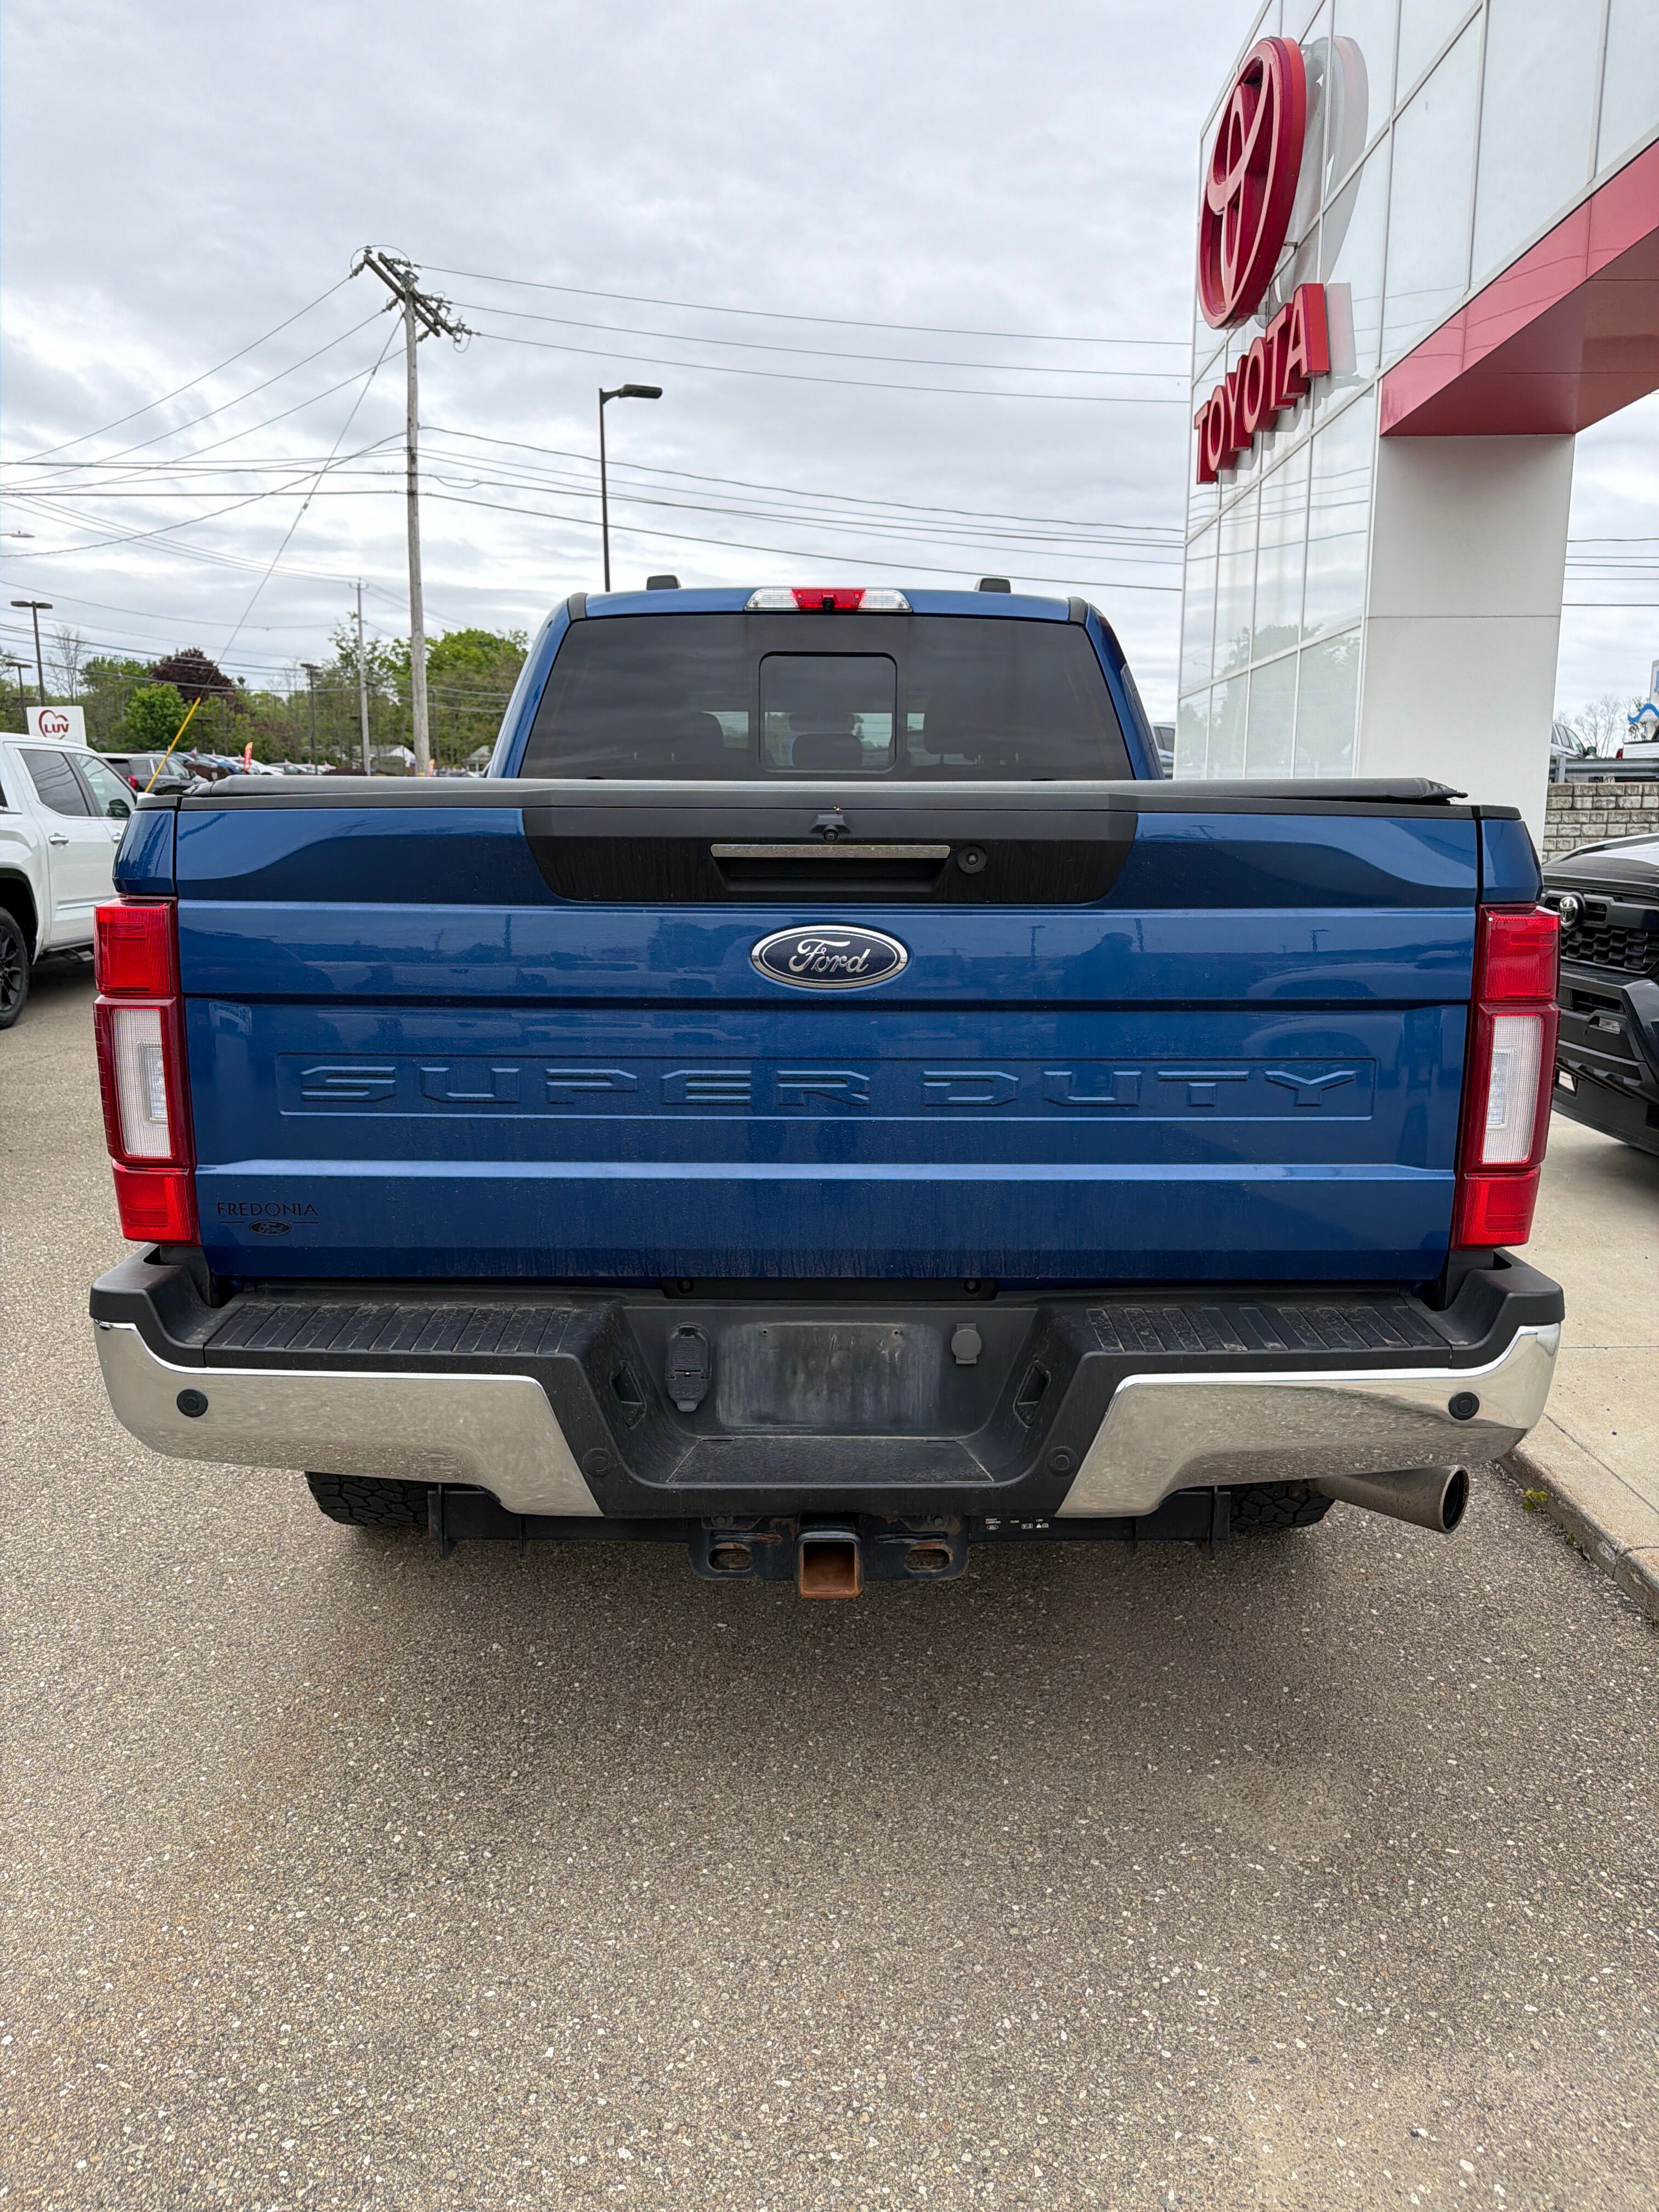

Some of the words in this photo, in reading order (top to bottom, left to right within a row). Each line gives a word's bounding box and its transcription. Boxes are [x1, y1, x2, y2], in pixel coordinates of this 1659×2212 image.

[1194, 283, 1330, 485] TOYOTA
[43, 723, 70, 733] LUV
[788, 938, 871, 973] Ford
[300, 1065, 871, 1107] SUPER
[923, 1070, 1357, 1107] DUTY
[217, 1201, 319, 1216] FREDONIA
